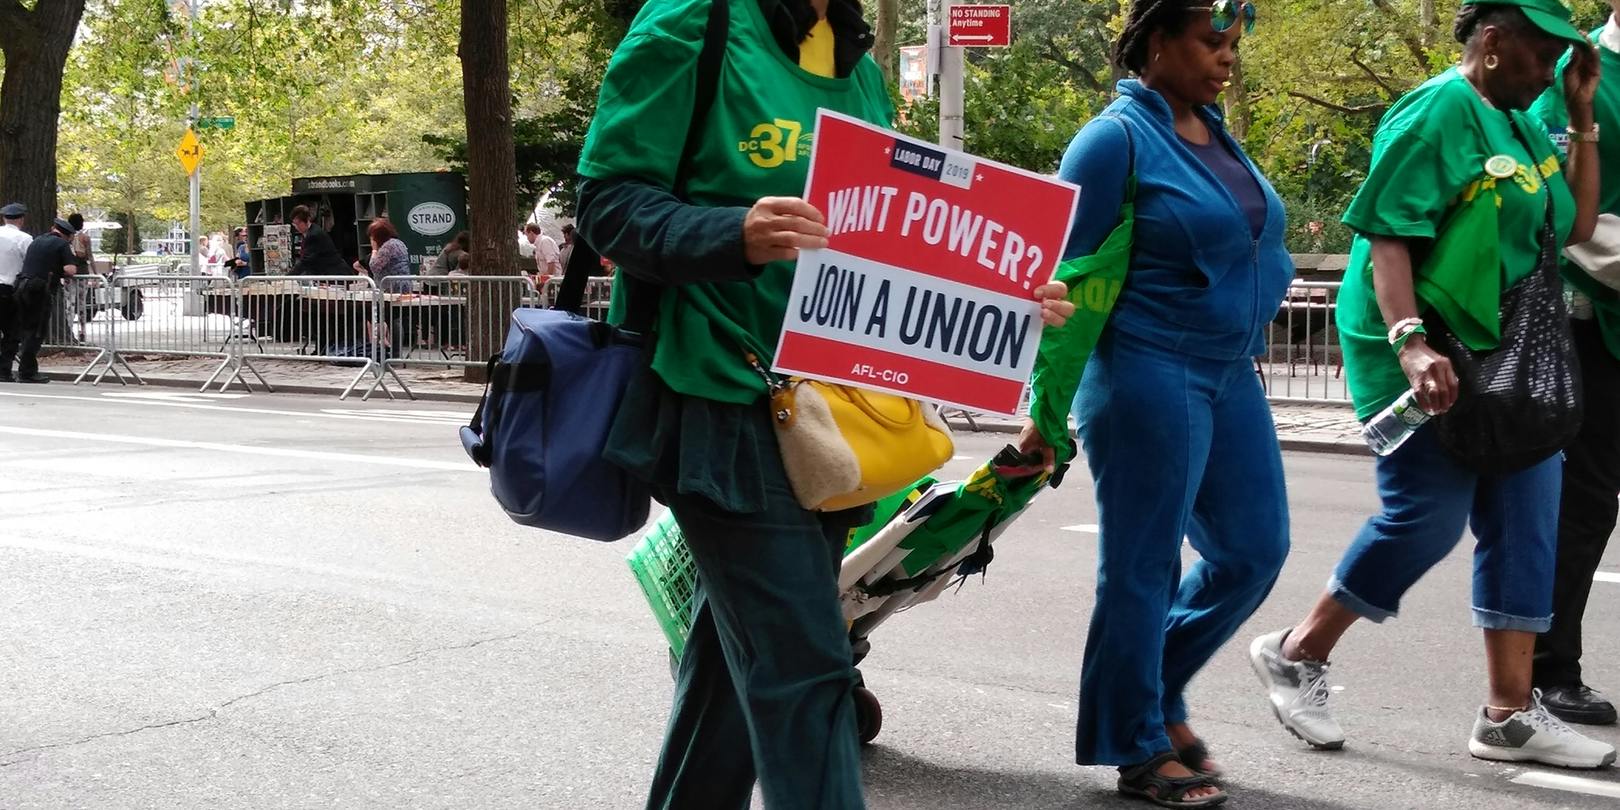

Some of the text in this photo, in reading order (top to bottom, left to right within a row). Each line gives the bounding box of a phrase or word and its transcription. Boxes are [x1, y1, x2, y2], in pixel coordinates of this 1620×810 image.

[952, 9, 1001, 18] NO STANDING
[952, 19, 983, 28] Anytime
[738, 118, 802, 168] DC 37
[894, 149, 969, 180] LABOR DAY 2019
[412, 213, 453, 224] STRAND
[826, 185, 1043, 290] WANT POWER?
[800, 263, 866, 332] JOIN
[864, 279, 891, 338] A
[899, 286, 1031, 369] UNION
[850, 363, 909, 385] AFL-CIO
